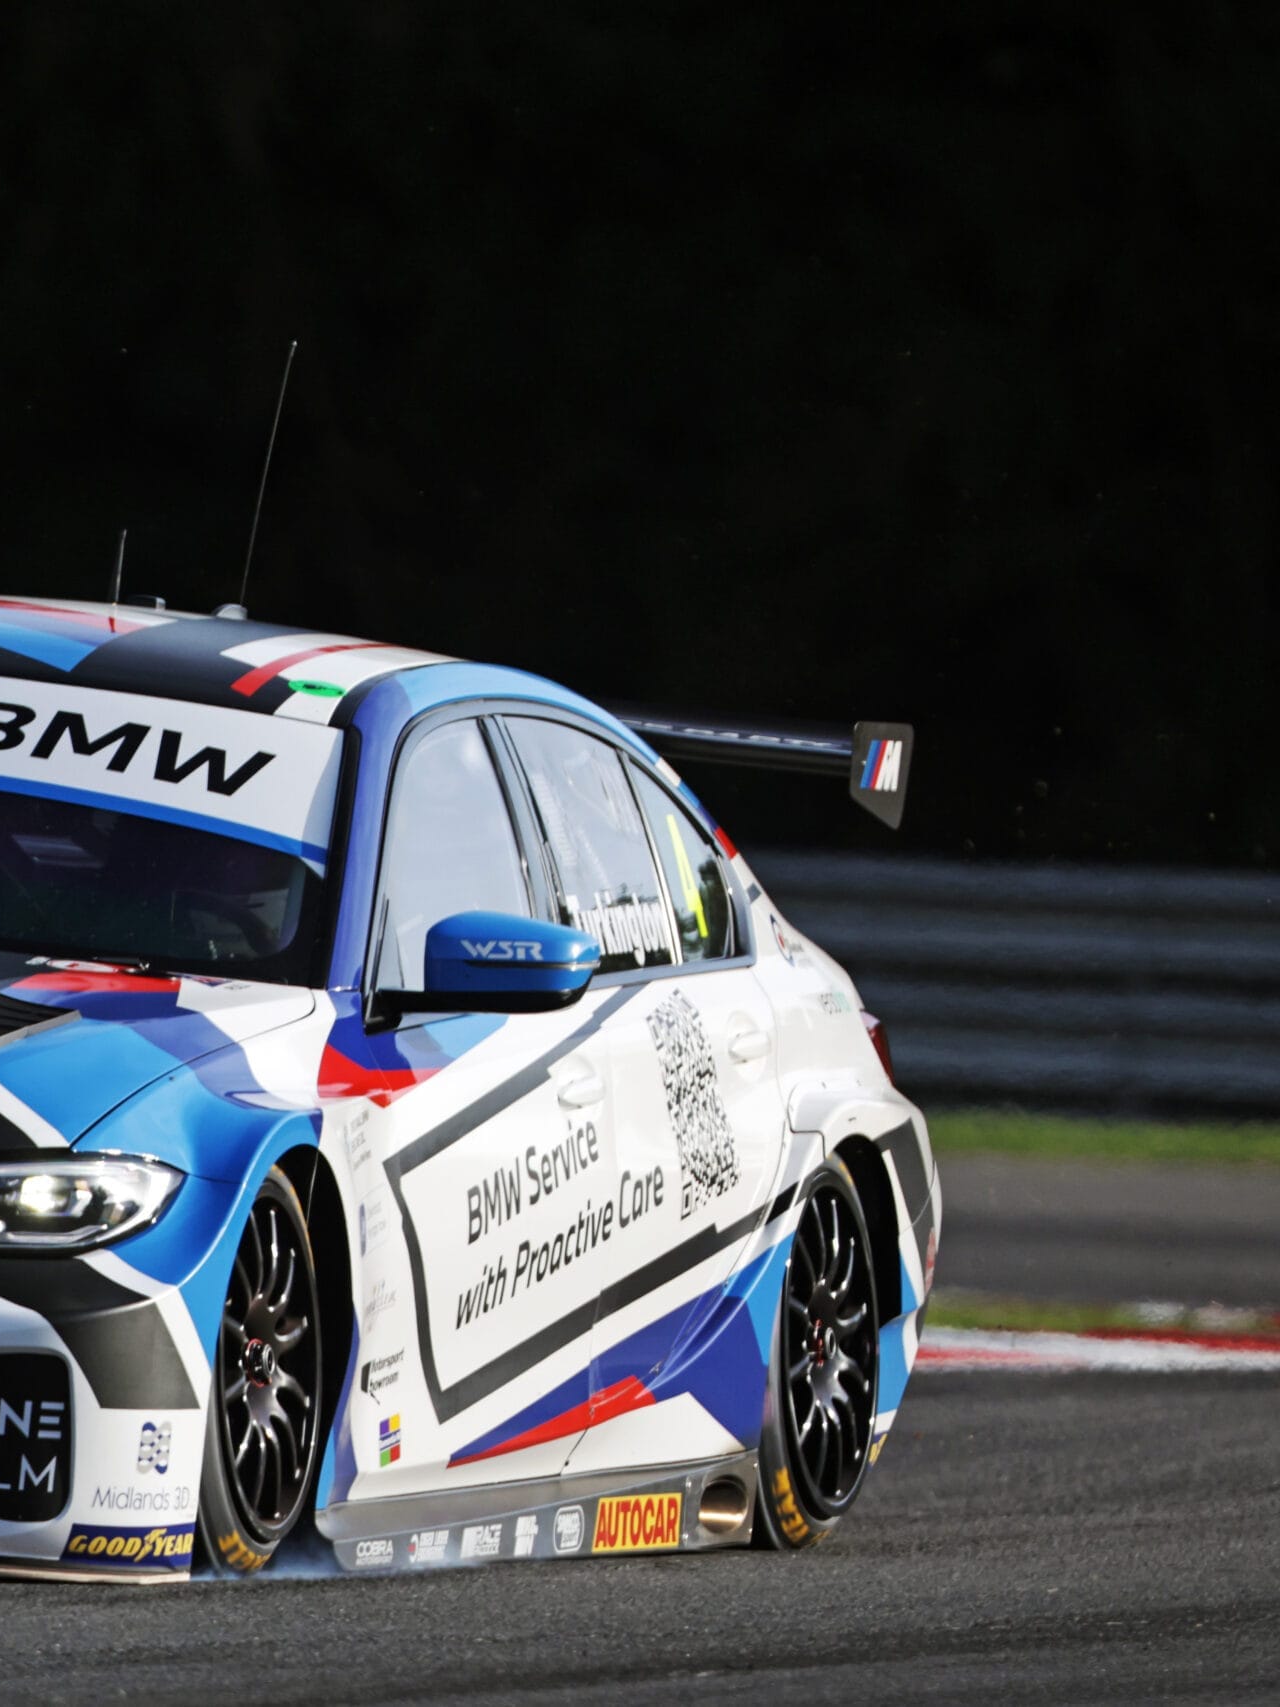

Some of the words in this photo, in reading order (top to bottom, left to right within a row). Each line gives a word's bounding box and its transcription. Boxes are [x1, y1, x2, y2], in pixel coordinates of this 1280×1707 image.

[459, 938, 544, 962] WSR
[467, 1171, 521, 1245] BMW
[528, 1119, 600, 1205] Service
[455, 1255, 509, 1330] with
[511, 1197, 614, 1299] Proactive
[619, 1164, 665, 1229] Care
[90, 1486, 170, 1512] Midlands
[173, 1485, 190, 1511] 3D
[594, 1498, 678, 1549] AUTOCAR
